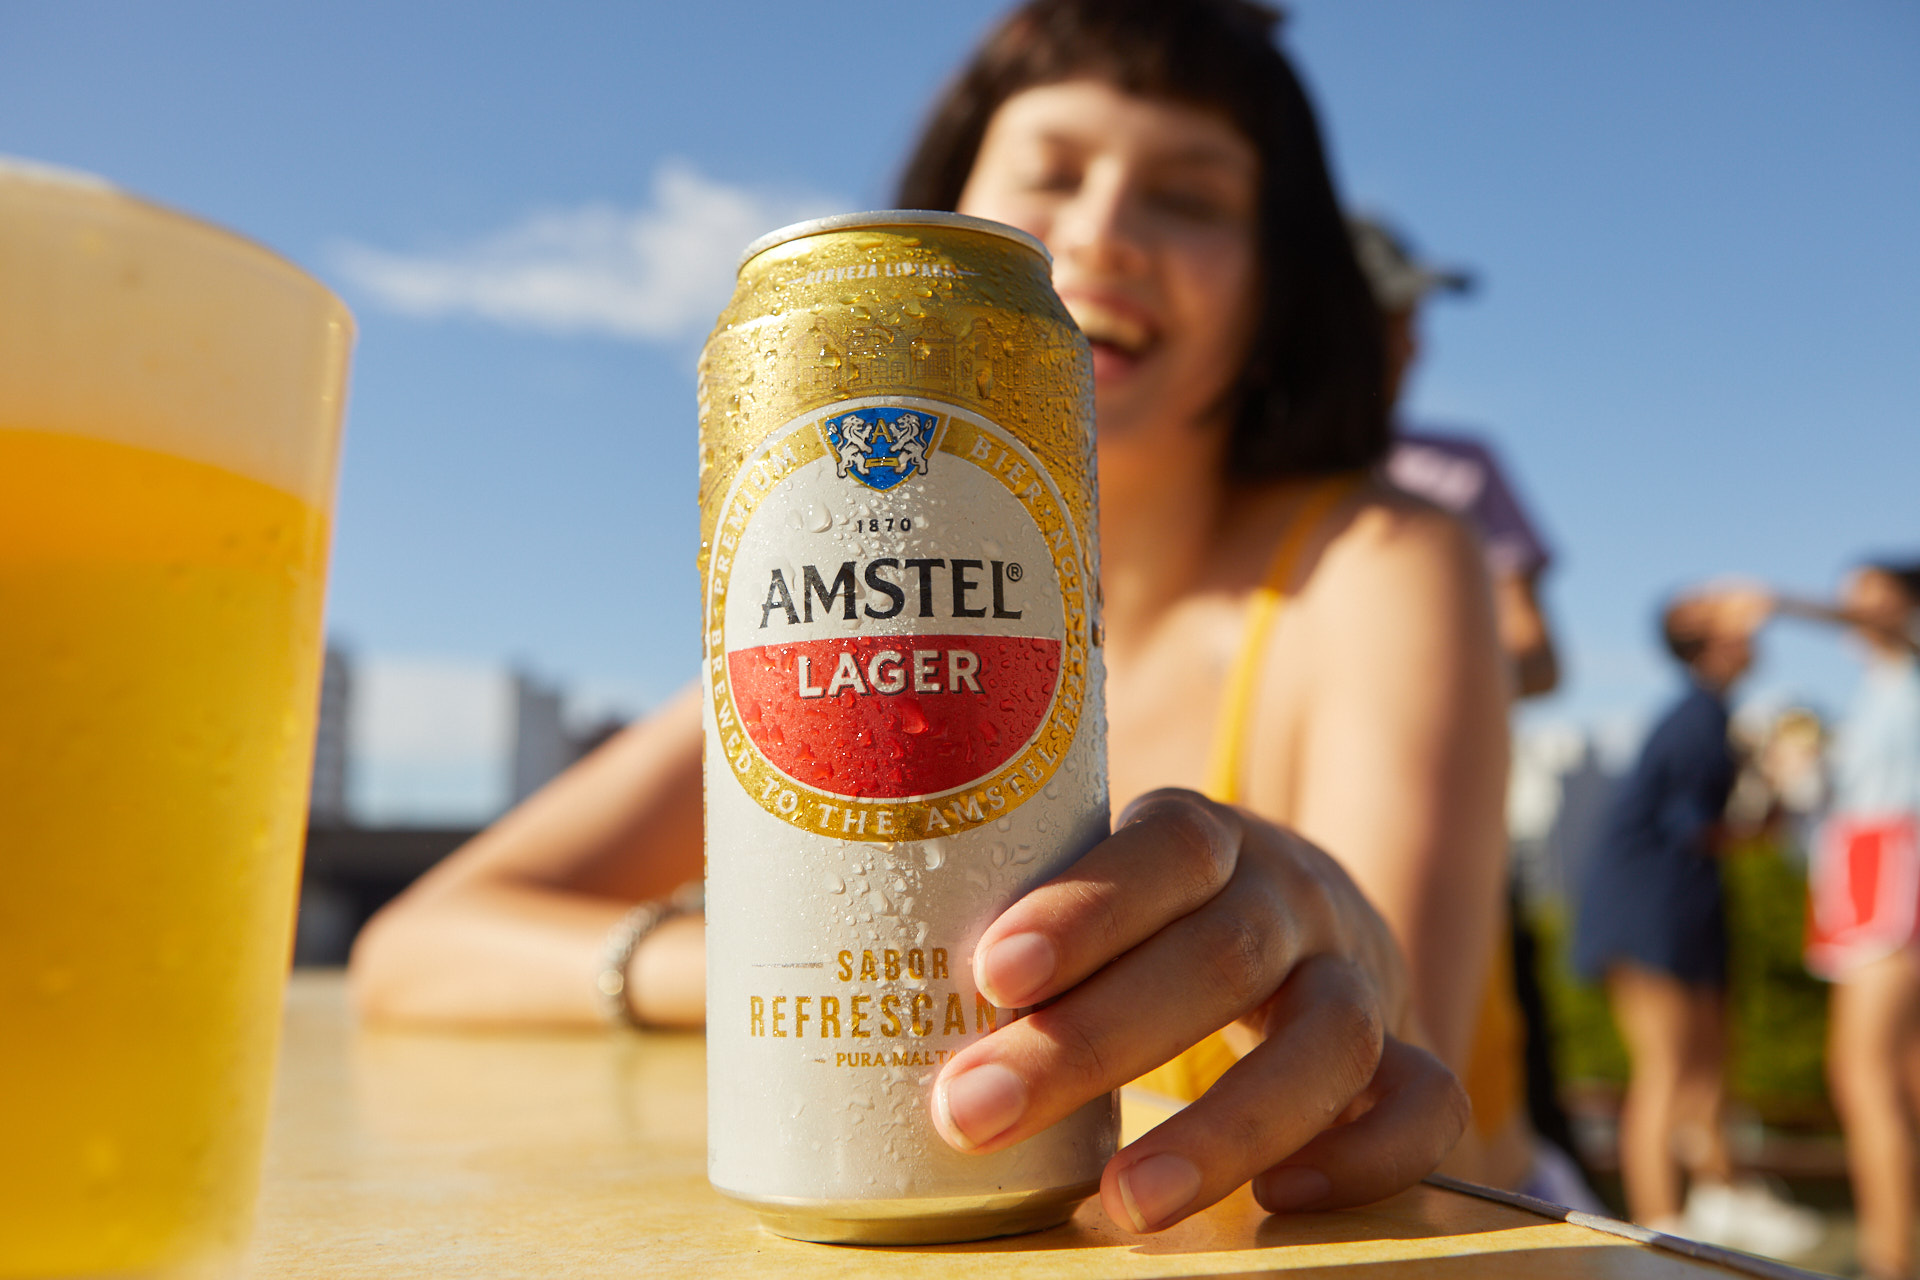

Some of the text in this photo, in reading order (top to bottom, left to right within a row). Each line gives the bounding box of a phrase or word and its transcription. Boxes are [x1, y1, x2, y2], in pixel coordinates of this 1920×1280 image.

[804, 263, 878, 286] CERVEZA
[870, 417, 894, 444] A
[713, 434, 1043, 597] PREMIUM BIER
[856, 517, 912, 534] 1870
[710, 527, 1085, 835] BREWED TO THE AMSTEL TRADITION
[797, 649, 986, 699] LAGER
[837, 947, 950, 982] SABOR
[750, 991, 1020, 1039] REFRESCAN
[836, 1051, 886, 1068] PURA
